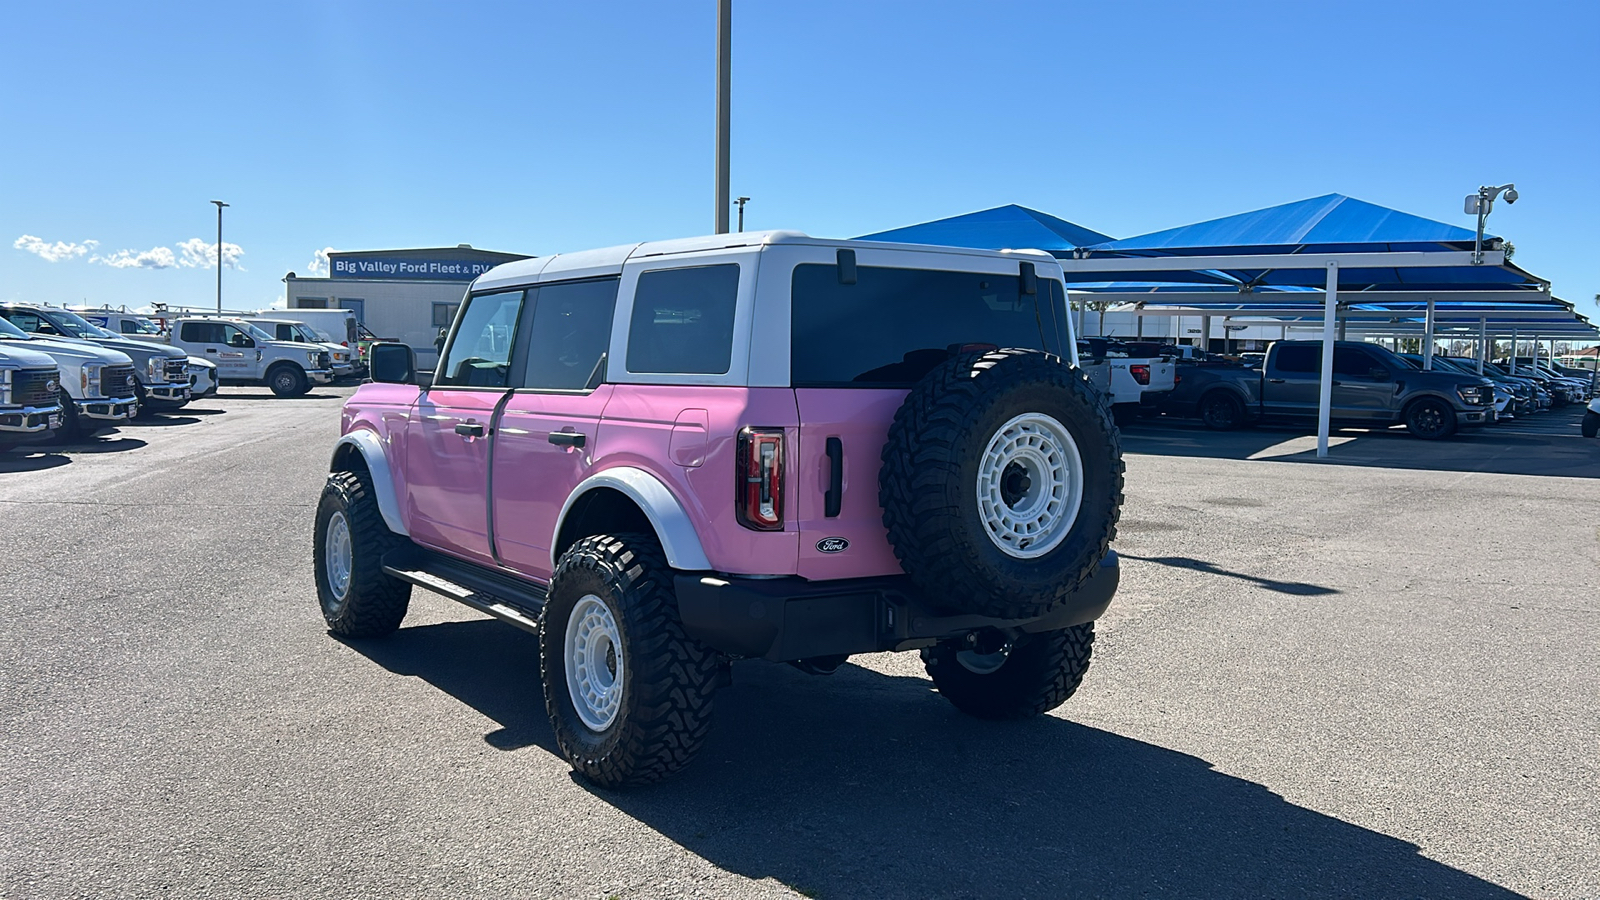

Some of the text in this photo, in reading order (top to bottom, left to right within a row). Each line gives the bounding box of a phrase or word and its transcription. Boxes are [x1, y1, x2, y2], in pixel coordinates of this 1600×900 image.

[336, 261, 490, 274] Big Valley Ford Fleet & RV
[822, 539, 845, 551] Ford
